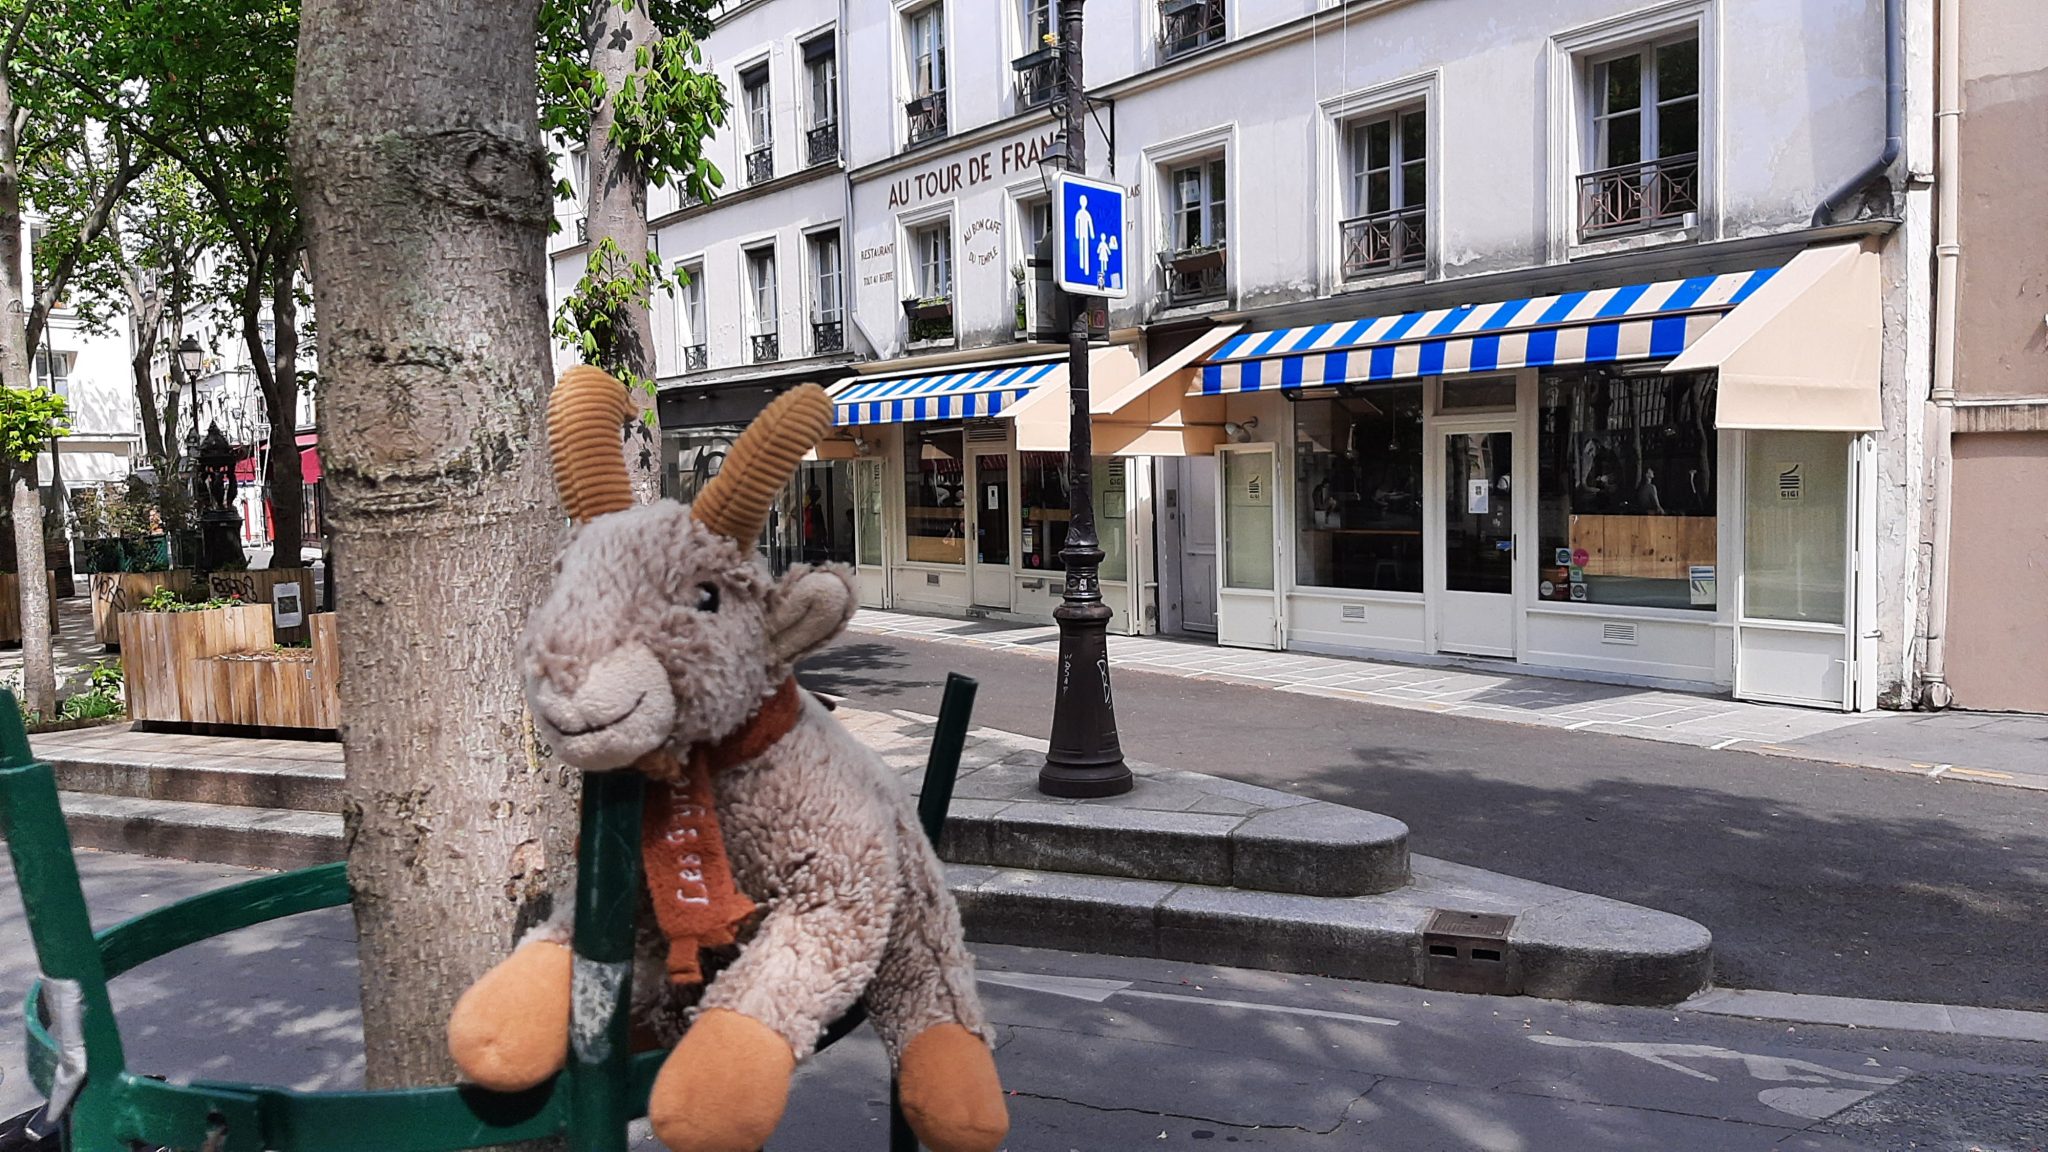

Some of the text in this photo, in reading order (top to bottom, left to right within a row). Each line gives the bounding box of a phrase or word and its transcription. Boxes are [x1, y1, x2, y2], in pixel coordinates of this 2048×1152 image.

[888, 132, 1055, 210] AU TOUR DE FRAN
[963, 227, 972, 246] AU
[972, 219, 984, 235] BON
[860, 242, 894, 261] RESTAURANT
[968, 246, 998, 266] DU TEMPLE
